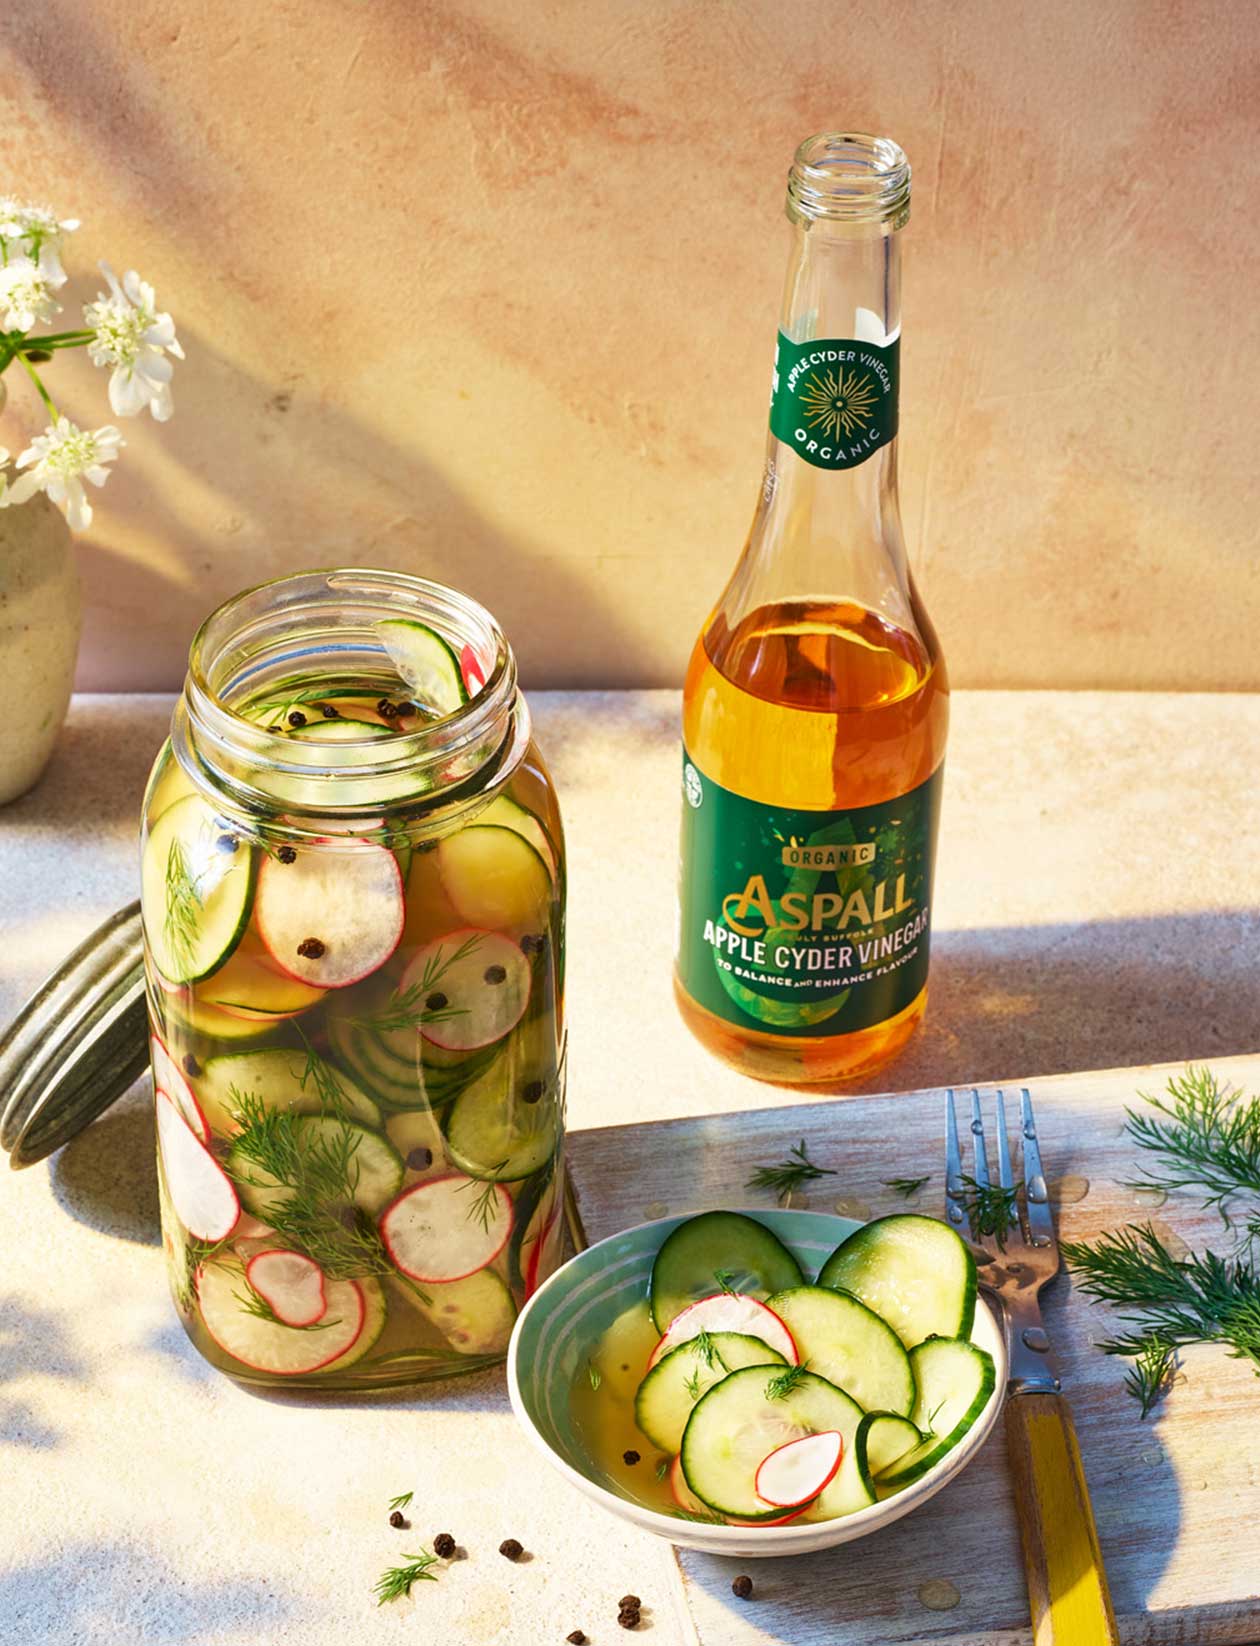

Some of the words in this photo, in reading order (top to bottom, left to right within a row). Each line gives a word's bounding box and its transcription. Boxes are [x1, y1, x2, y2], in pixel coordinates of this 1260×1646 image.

[787, 357, 810, 393] APPLE
[809, 351, 856, 364] CYDER
[860, 352, 891, 394] VINEGAR
[794, 428, 880, 460] ORGANIC
[790, 847, 869, 865] ORGANIC
[703, 919, 766, 965] APPLE
[775, 946, 853, 970] CYDER
[858, 907, 929, 964] VINEGAR
[717, 958, 732, 971] TO
[734, 966, 793, 987] BALANCE
[793, 979, 813, 988] AND
[815, 973, 873, 988] ENHANCE
[877, 946, 918, 976] FLAVOUR
